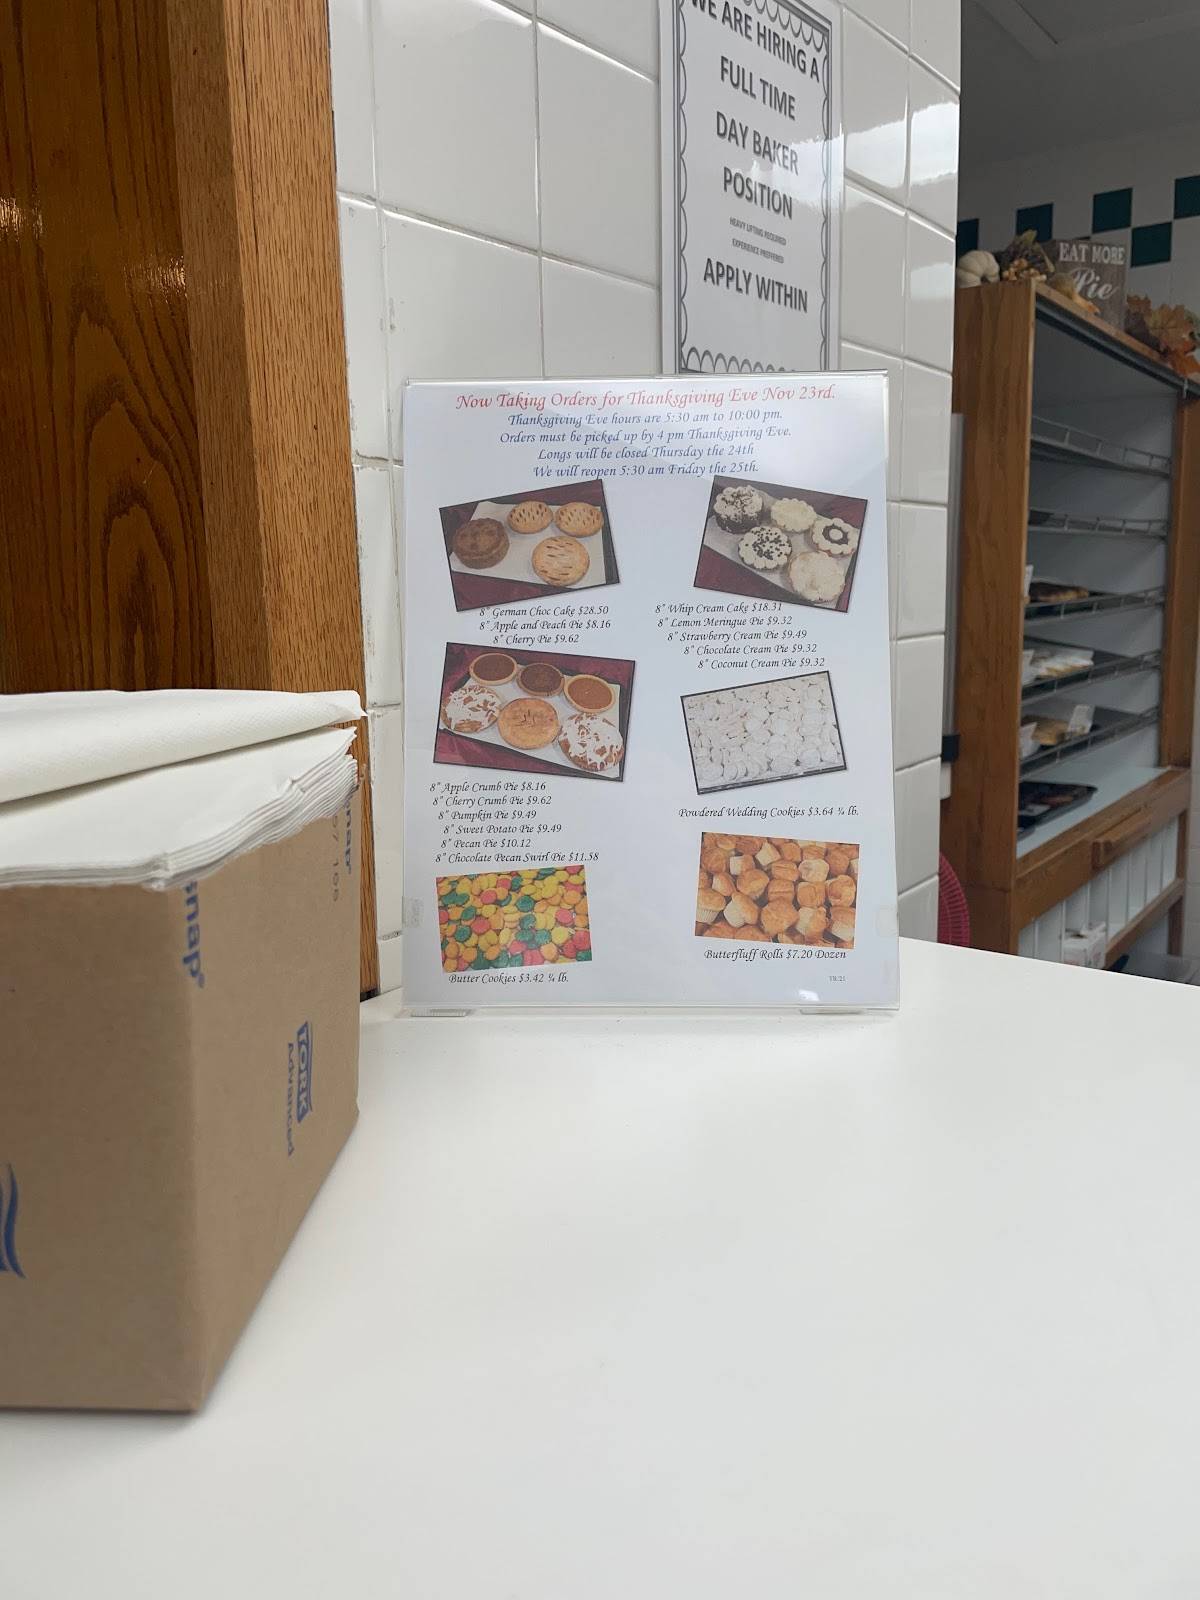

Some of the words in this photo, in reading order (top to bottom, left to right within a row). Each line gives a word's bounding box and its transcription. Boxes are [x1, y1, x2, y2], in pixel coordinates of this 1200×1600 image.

[722, 1, 752, 42] ARE
[757, 21, 806, 75] HIRING
[811, 57, 819, 83] A
[721, 55, 756, 99] FULL
[760, 78, 796, 121] TIME
[716, 111, 748, 150] DAY
[753, 130, 799, 176] BAKER
[724, 166, 792, 220] POSITION
[1059, 242, 1088, 263] EAT
[1092, 245, 1124, 265] MORE
[703, 257, 752, 296] APPLY
[756, 273, 808, 314] WITHIN
[1071, 268, 1120, 300] Pie
[456, 395, 492, 409] Now
[496, 392, 546, 410] Taking
[551, 392, 597, 406] Orders
[598, 390, 623, 410] for
[626, 390, 724, 408] Thanksgiving
[728, 389, 757, 402] Eve
[761, 387, 795, 401] Nov
[799, 384, 836, 400] 23rd.
[508, 414, 582, 428] Thanksgiving
[586, 413, 607, 424] Eve
[611, 412, 641, 424] hours
[644, 414, 661, 423] are
[665, 411, 689, 423] 5:30
[692, 413, 709, 422] am
[713, 412, 724, 421] to
[728, 409, 760, 421] 10:00
[761, 411, 782, 424] pm.
[500, 431, 536, 443] Orders
[539, 433, 566, 442] must
[570, 431, 581, 442] be
[584, 430, 620, 445] picked
[623, 431, 638, 444] up
[641, 429, 654, 443] by
[657, 430, 664, 440] 4
[667, 431, 684, 443] pm
[687, 427, 762, 441] Thanksgiving
[765, 426, 791, 437] Eve.
[538, 448, 572, 463] Longs
[575, 448, 596, 459] will
[600, 447, 612, 458] be
[615, 446, 647, 458] closed
[652, 446, 703, 460] Thursday
[707, 445, 724, 456] the
[728, 442, 754, 456] 24th
[533, 466, 552, 477] We
[555, 465, 577, 477] will
[580, 468, 617, 480] reopen
[621, 465, 644, 476] 5:30
[647, 466, 664, 475] am
[668, 462, 705, 478] Friday
[709, 462, 727, 474] the
[492, 609, 527, 619] German
[529, 607, 550, 617] Choc
[553, 605, 575, 618] Cake
[578, 605, 609, 617] $28.50
[668, 603, 694, 615] Whip
[696, 604, 722, 613] Cream
[726, 602, 749, 614] Cake
[752, 602, 782, 613] $18.31
[491, 621, 519, 633] Apple
[521, 620, 538, 630] and
[540, 619, 566, 630] Peach
[570, 619, 583, 629] Pie
[586, 619, 611, 629] $8.16
[671, 618, 701, 628] Lemon
[704, 616, 747, 629] Meringue
[750, 616, 764, 626] Pie
[767, 615, 793, 627] $9.32
[505, 634, 535, 647] Cherry
[538, 633, 552, 643] Pie
[554, 633, 580, 645] $9.62
[680, 630, 731, 643] Strawberry
[734, 630, 761, 641] Cream
[764, 629, 779, 640] Pie
[782, 629, 807, 641] $9.49
[697, 645, 741, 655] Chocolate
[743, 643, 771, 654] Cream
[774, 643, 789, 653] Pie
[791, 643, 817, 654] $9.32
[711, 658, 748, 669] Coconut
[751, 658, 779, 668] Cream
[782, 657, 797, 667] Pie
[799, 657, 825, 667] $9.32
[441, 782, 470, 795] Apple
[472, 781, 502, 792] Crumb
[504, 781, 518, 792] Pie
[520, 781, 546, 792] $8.16
[446, 796, 475, 808] Cherry
[477, 796, 507, 806] Crumb
[509, 795, 524, 806] Pie
[526, 795, 552, 806] $9.62
[451, 810, 492, 822] Pumpkin
[495, 810, 509, 820] Pie
[511, 809, 537, 821] $9.49
[678, 807, 723, 817] Powdered
[725, 806, 768, 819] Wedding
[770, 807, 805, 818] Cookies
[808, 806, 834, 818] $3.64
[456, 825, 483, 835] Sweet
[486, 824, 517, 834] Potato
[519, 824, 533, 834] Pie
[537, 823, 562, 834] $9.49
[454, 839, 480, 849] Pecan
[482, 838, 498, 848] Pie
[500, 838, 531, 849] $10.12
[448, 852, 492, 864] Chocolate
[494, 853, 521, 863] Pecan
[522, 851, 550, 863] Swirl
[551, 852, 566, 862] Pie
[569, 851, 599, 862] $11.58
[704, 948, 758, 962] Butterfluff
[760, 949, 784, 960] Rolls
[786, 949, 813, 960] $7.20
[815, 949, 848, 959] Dozen
[449, 974, 480, 983] Butter
[482, 973, 517, 985] Cookies
[519, 973, 545, 983] $3.42
[298, 1023, 309, 1119] TORK
